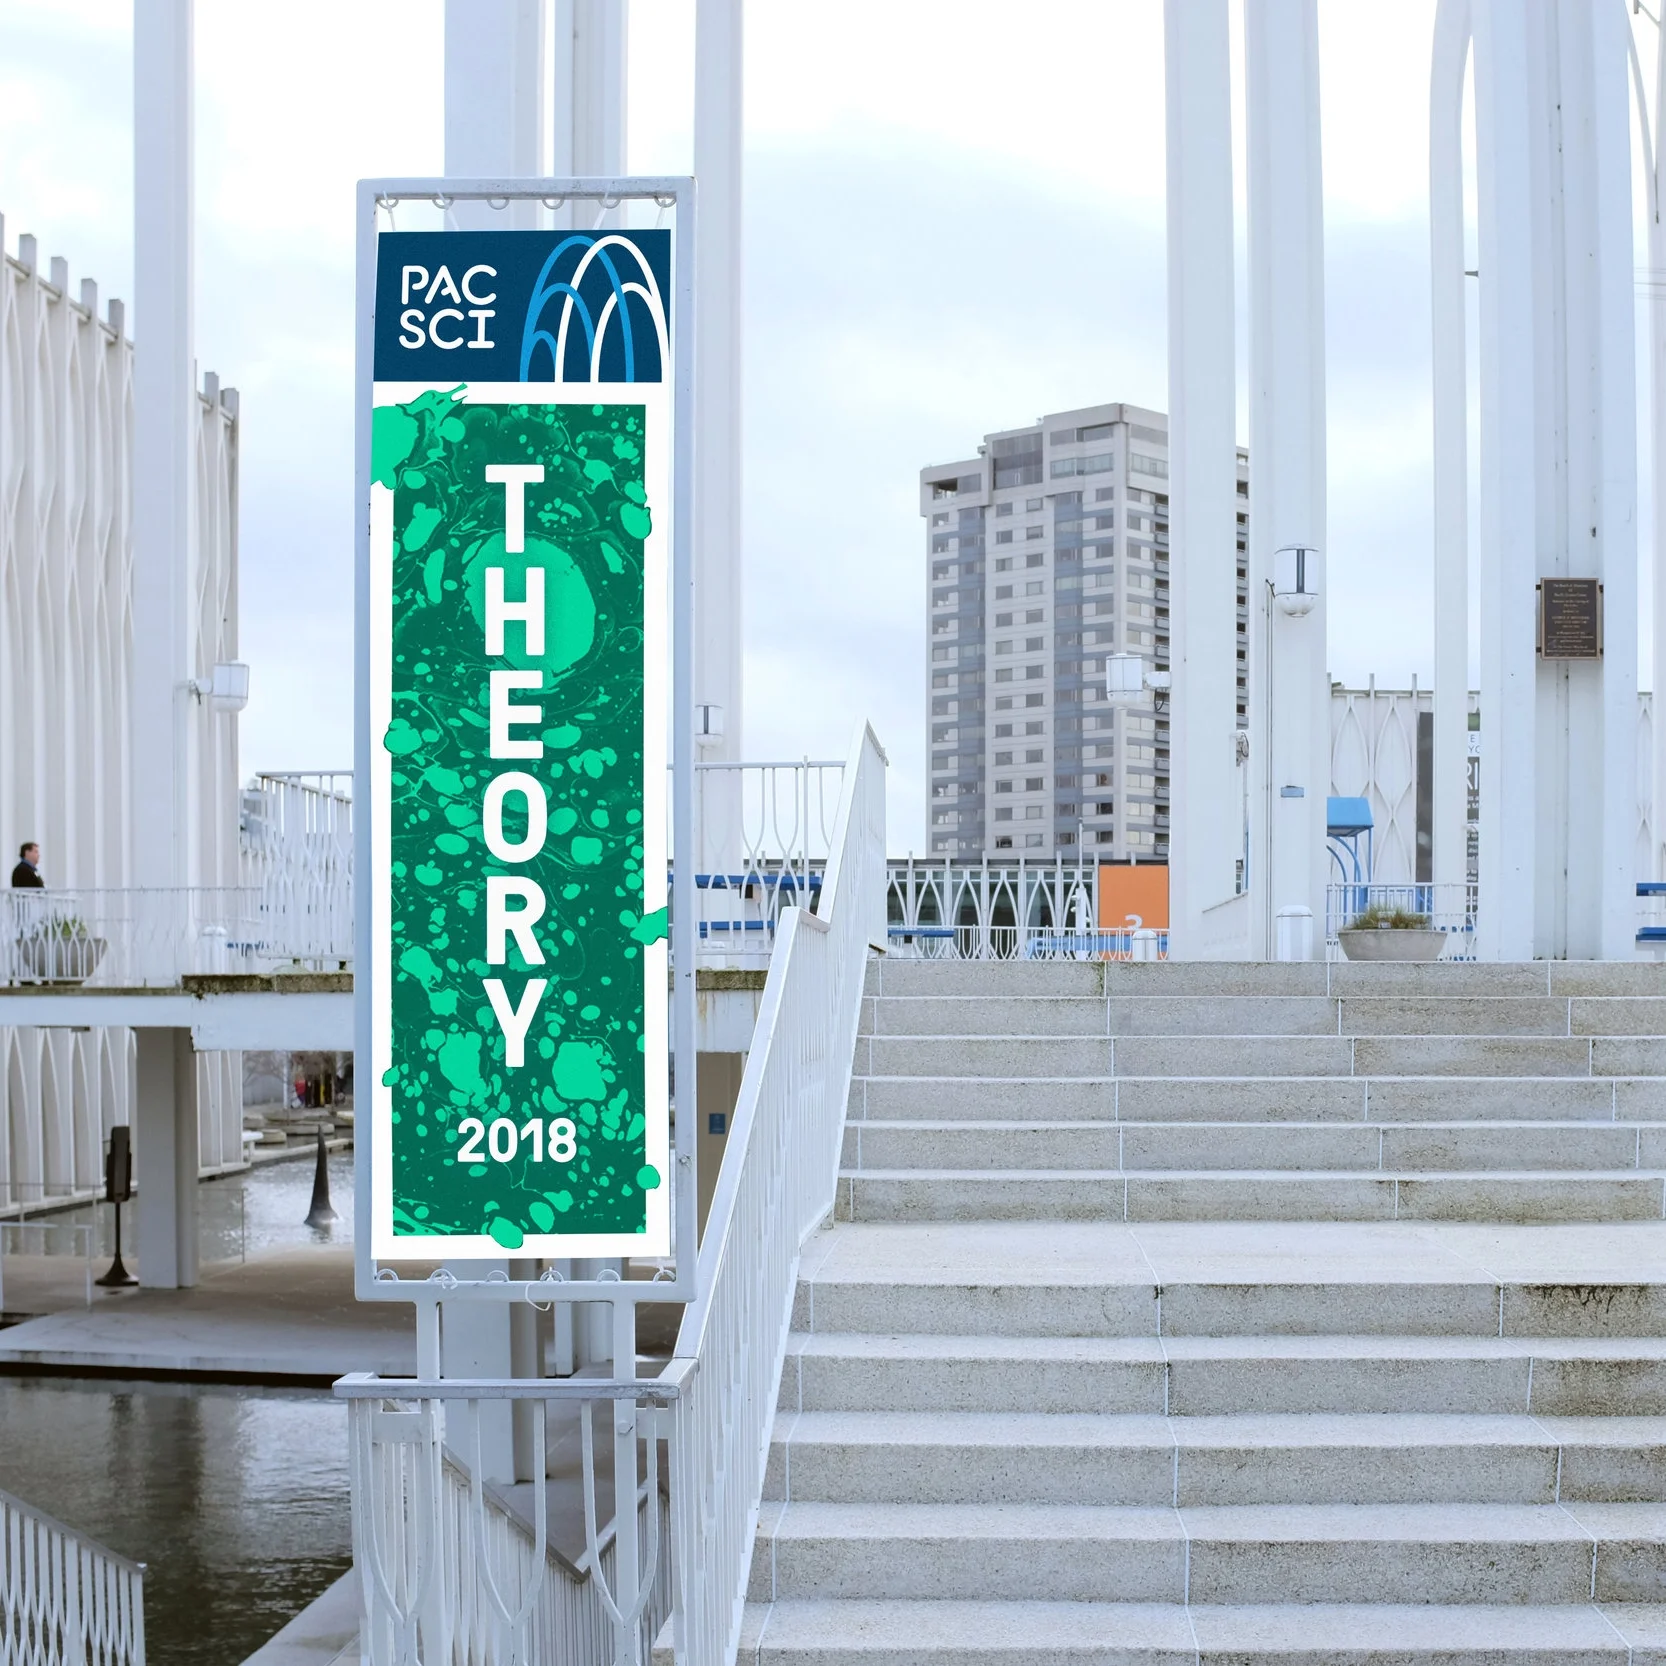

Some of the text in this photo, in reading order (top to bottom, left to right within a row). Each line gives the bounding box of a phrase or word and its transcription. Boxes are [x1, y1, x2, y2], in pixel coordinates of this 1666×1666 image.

[402, 265, 497, 305] PAC
[399, 309, 495, 349] SCI
[483, 465, 547, 1067] THEORY
[458, 1118, 576, 1162] 2018
